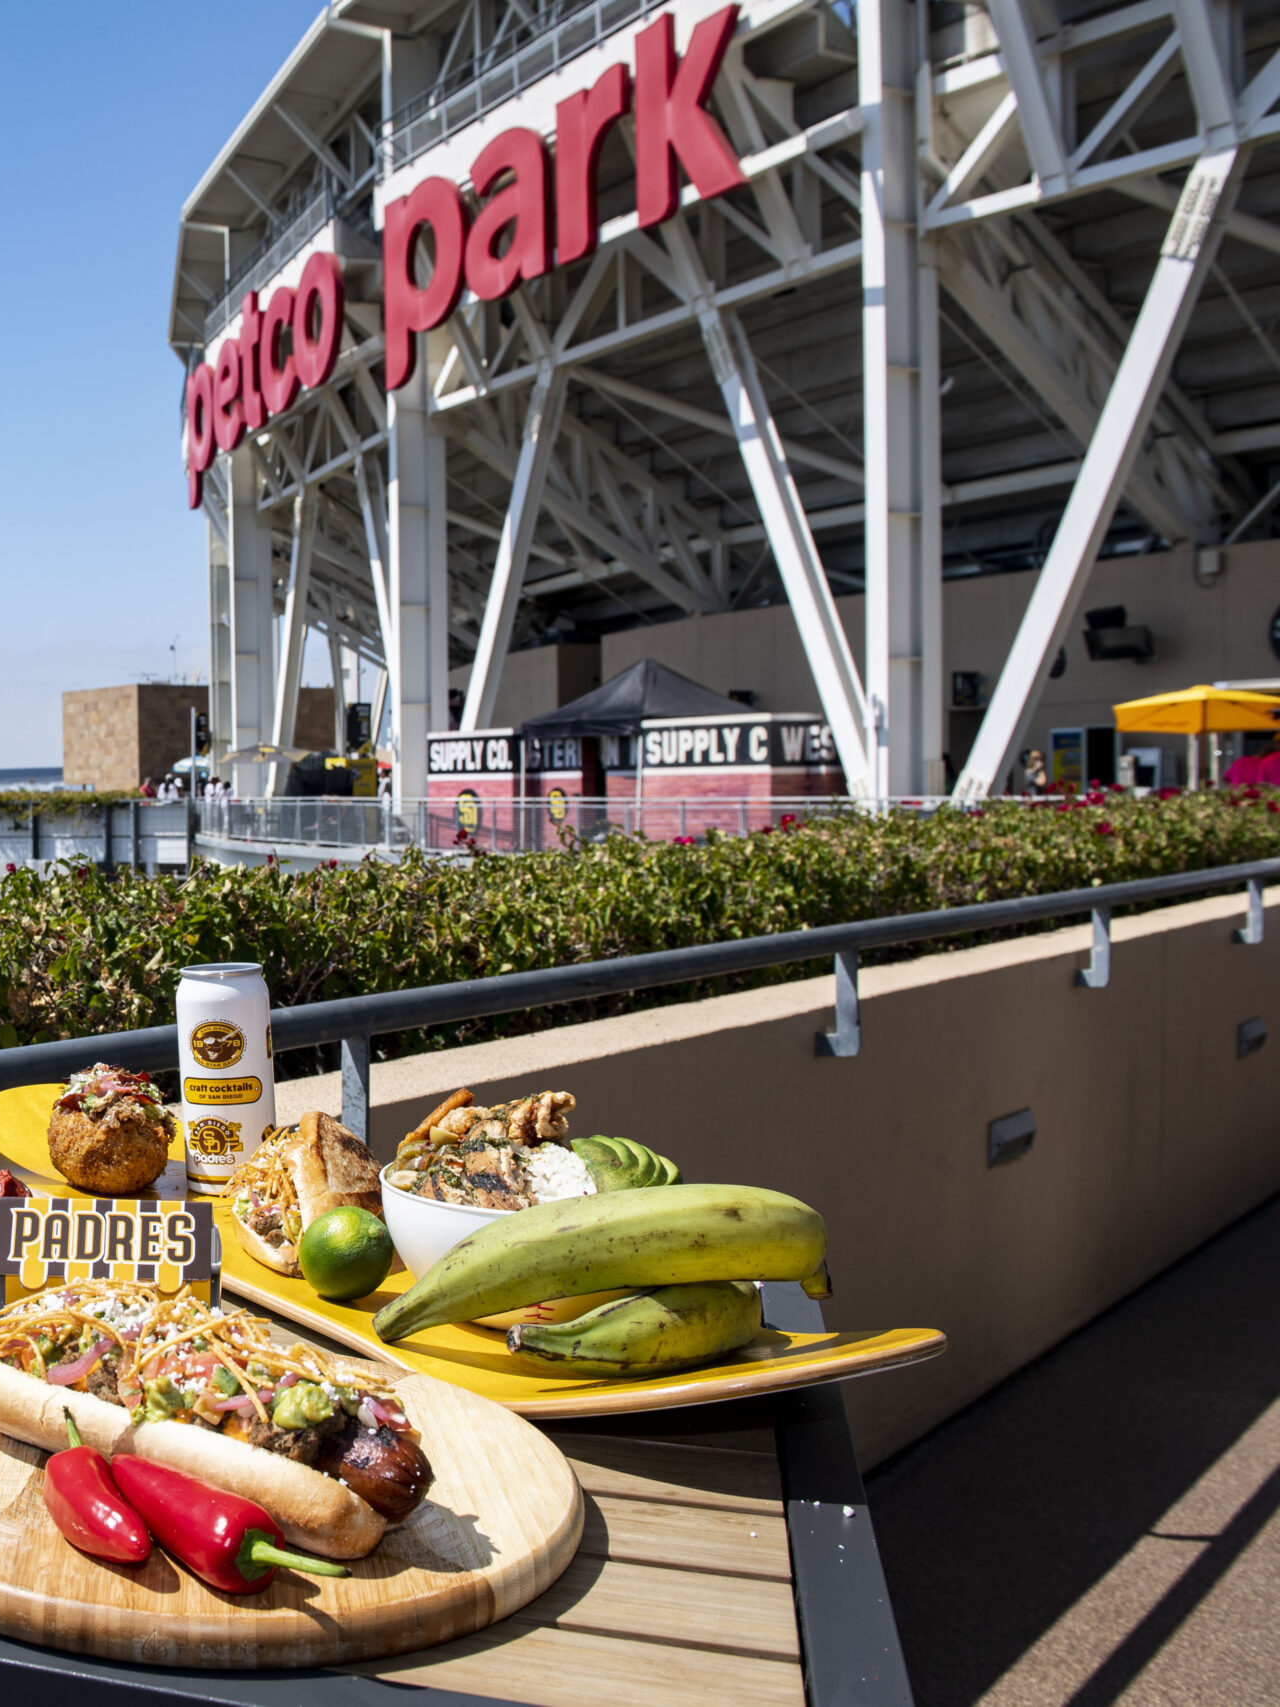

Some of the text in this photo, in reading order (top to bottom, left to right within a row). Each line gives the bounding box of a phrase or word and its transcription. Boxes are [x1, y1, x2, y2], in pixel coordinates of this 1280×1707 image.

[186, 4, 751, 511] petco park
[429, 738, 514, 772] SUPPLY CO.
[646, 727, 741, 765] SUPPLY
[189, 1082, 253, 1093] craft cocktails
[193, 1153, 236, 1168] padres
[7, 1208, 196, 1266] PADRES
